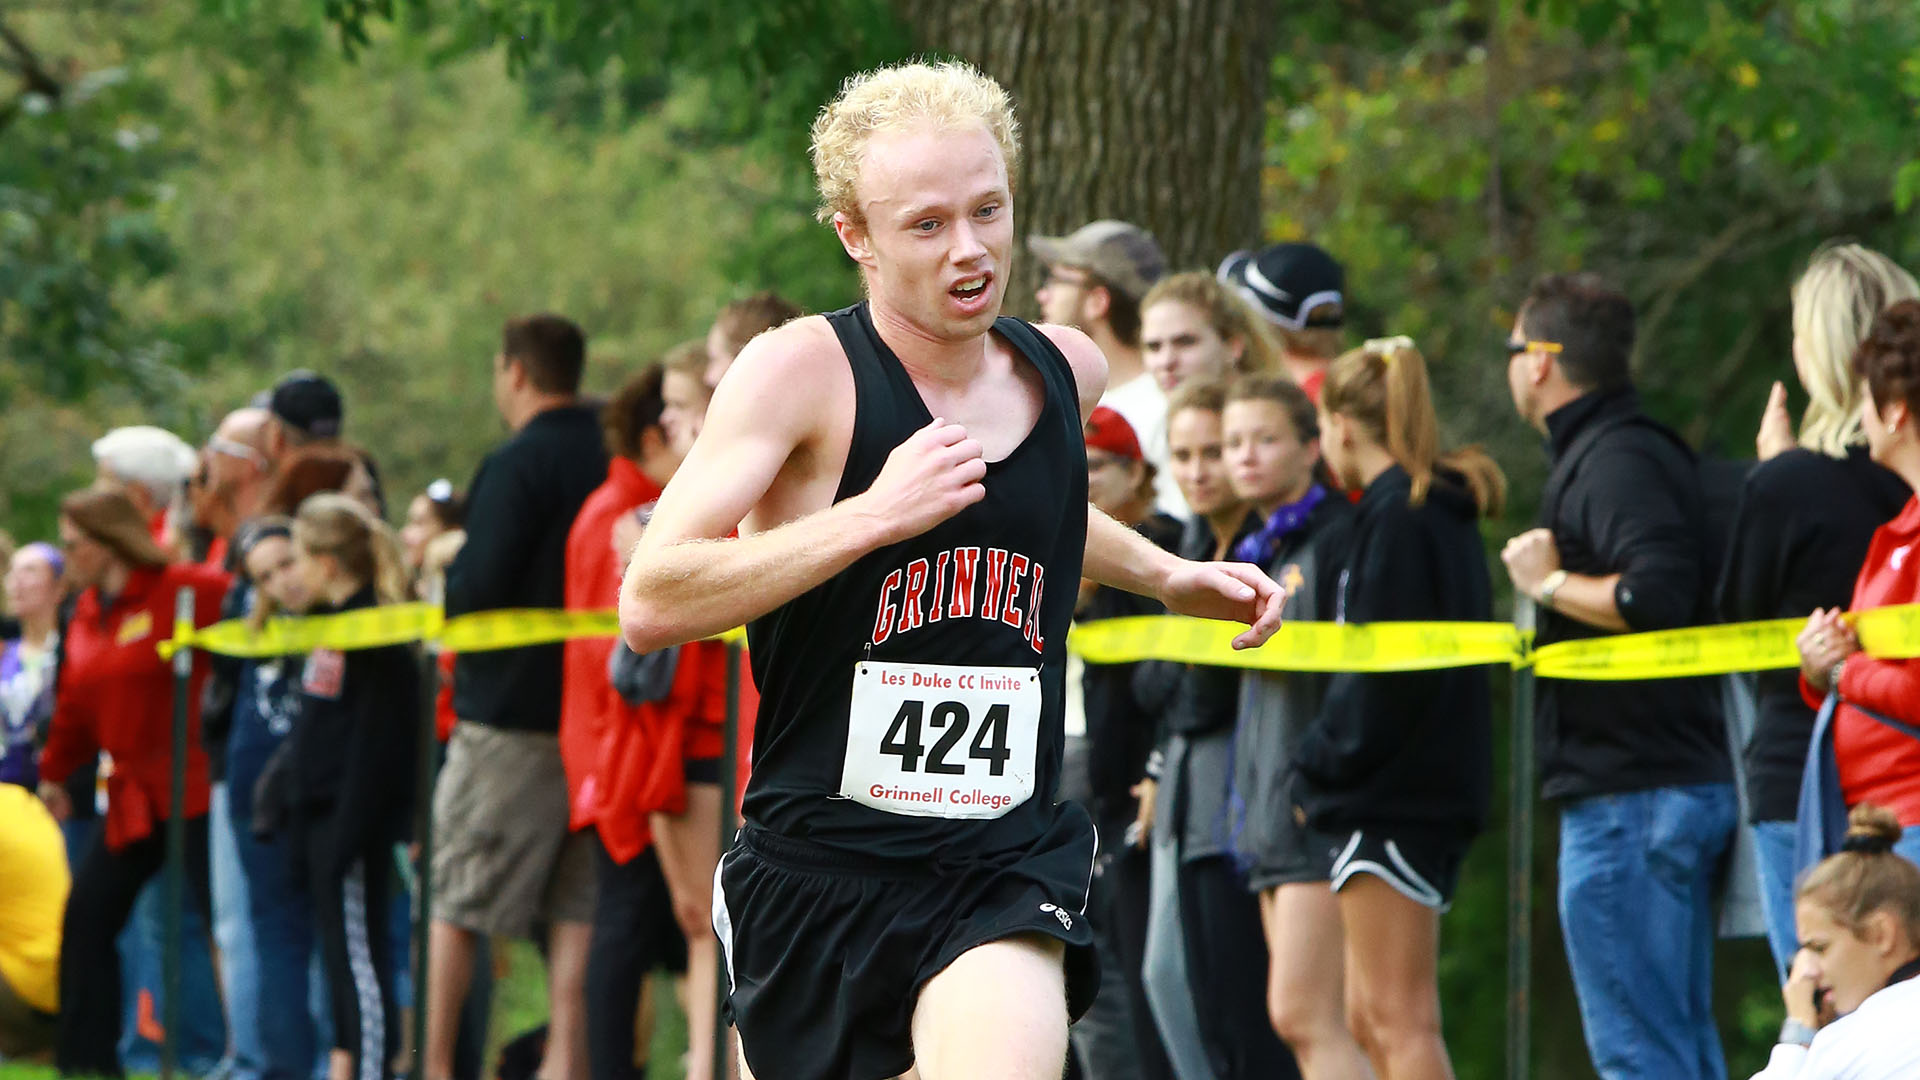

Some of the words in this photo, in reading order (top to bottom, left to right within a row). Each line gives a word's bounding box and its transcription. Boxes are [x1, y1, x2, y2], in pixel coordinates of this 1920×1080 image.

[881, 670, 906, 686] Les
[912, 672, 952, 689] Duke
[958, 675, 975, 690] CC
[980, 676, 1021, 691] Invite
[879, 699, 1011, 777] 424
[869, 784, 943, 803] Grinnell
[949, 789, 1012, 809] College
